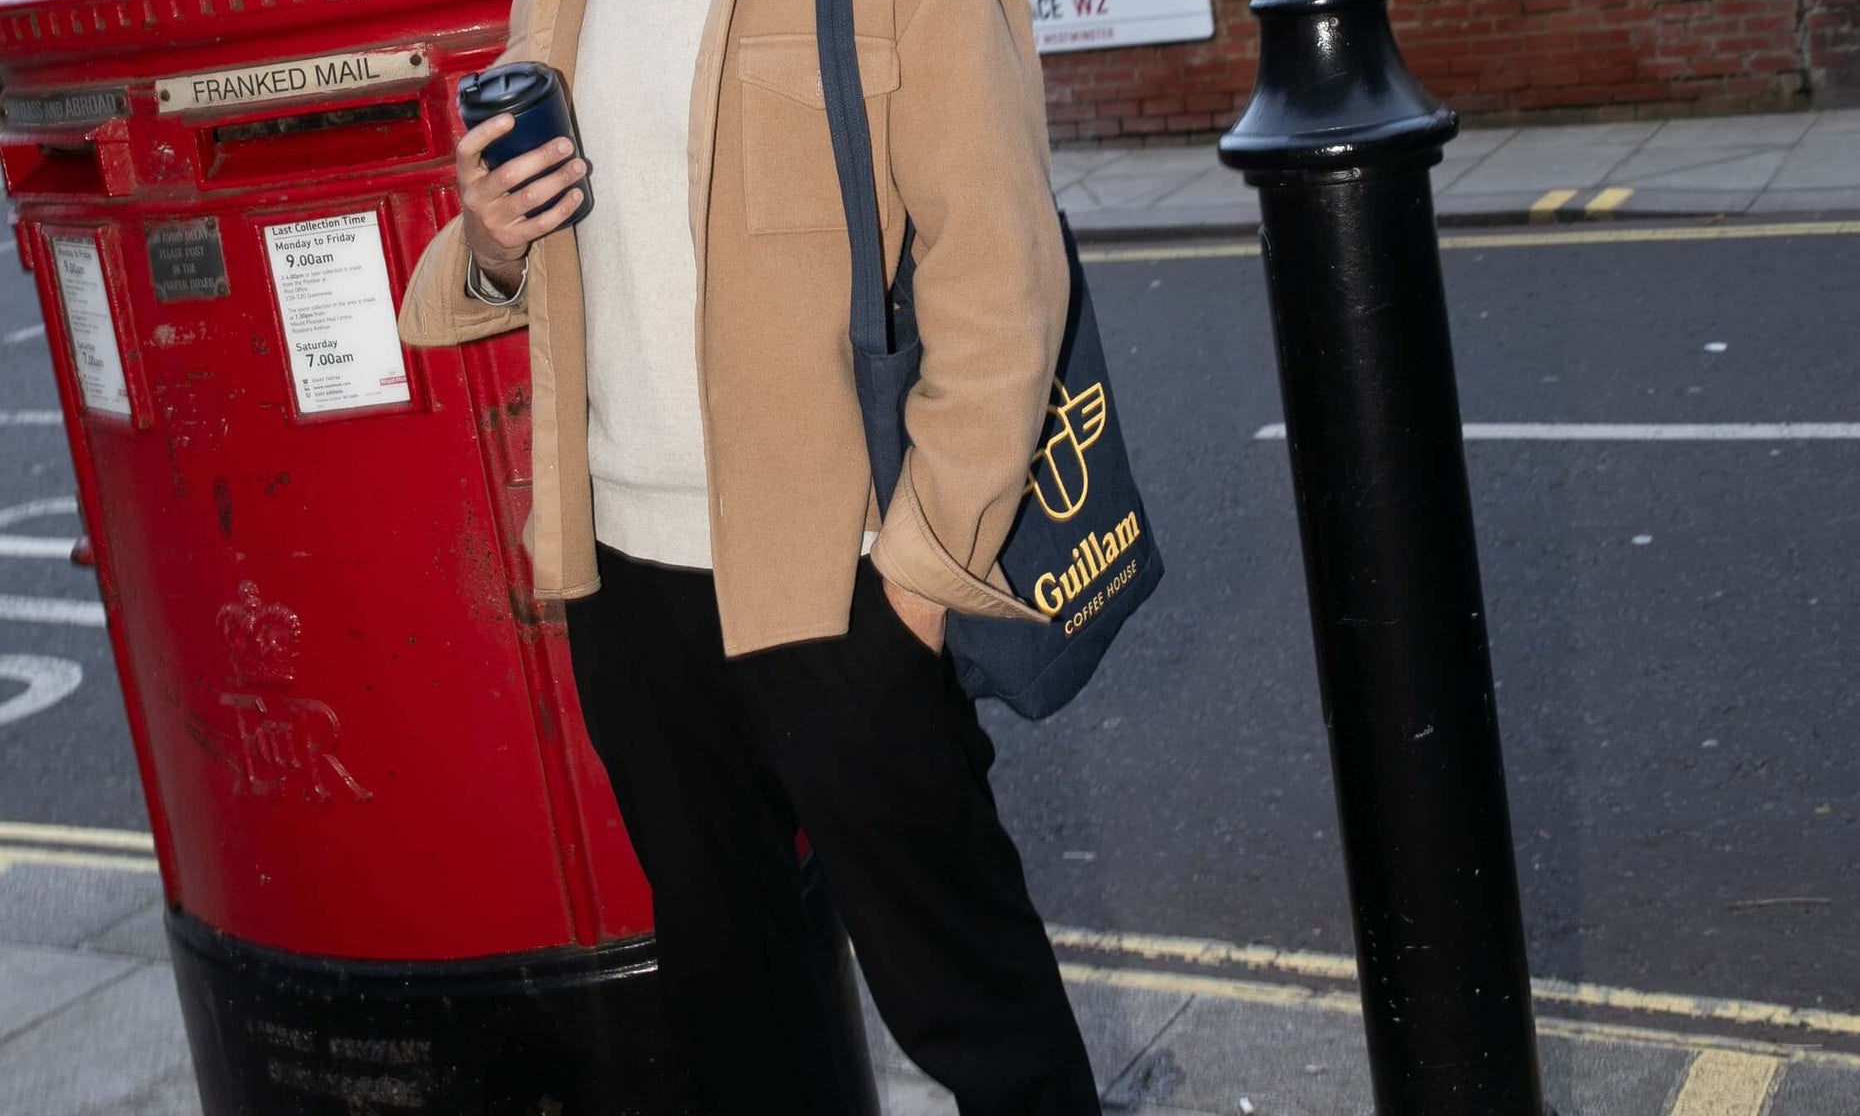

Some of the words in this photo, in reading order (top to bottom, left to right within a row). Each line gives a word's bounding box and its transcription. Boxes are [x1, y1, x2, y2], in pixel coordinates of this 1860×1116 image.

[192, 67, 307, 104] FRANKED
[315, 57, 381, 87] MAIL
[65, 92, 117, 118] ABROAD
[272, 223, 292, 236] Last
[294, 218, 340, 233] Collection
[341, 215, 366, 227] Time
[185, 244, 205, 258] POST
[275, 236, 312, 251] Monday
[314, 237, 324, 246] to
[326, 233, 356, 245] Friday
[183, 263, 197, 274] THE
[286, 252, 334, 269] 9.00am
[296, 339, 338, 353] Saturday
[305, 352, 354, 368] 7.00am
[1034, 510, 1141, 618] Guillam
[1064, 591, 1105, 635] COFFEE
[1106, 559, 1138, 599] HOUSE
